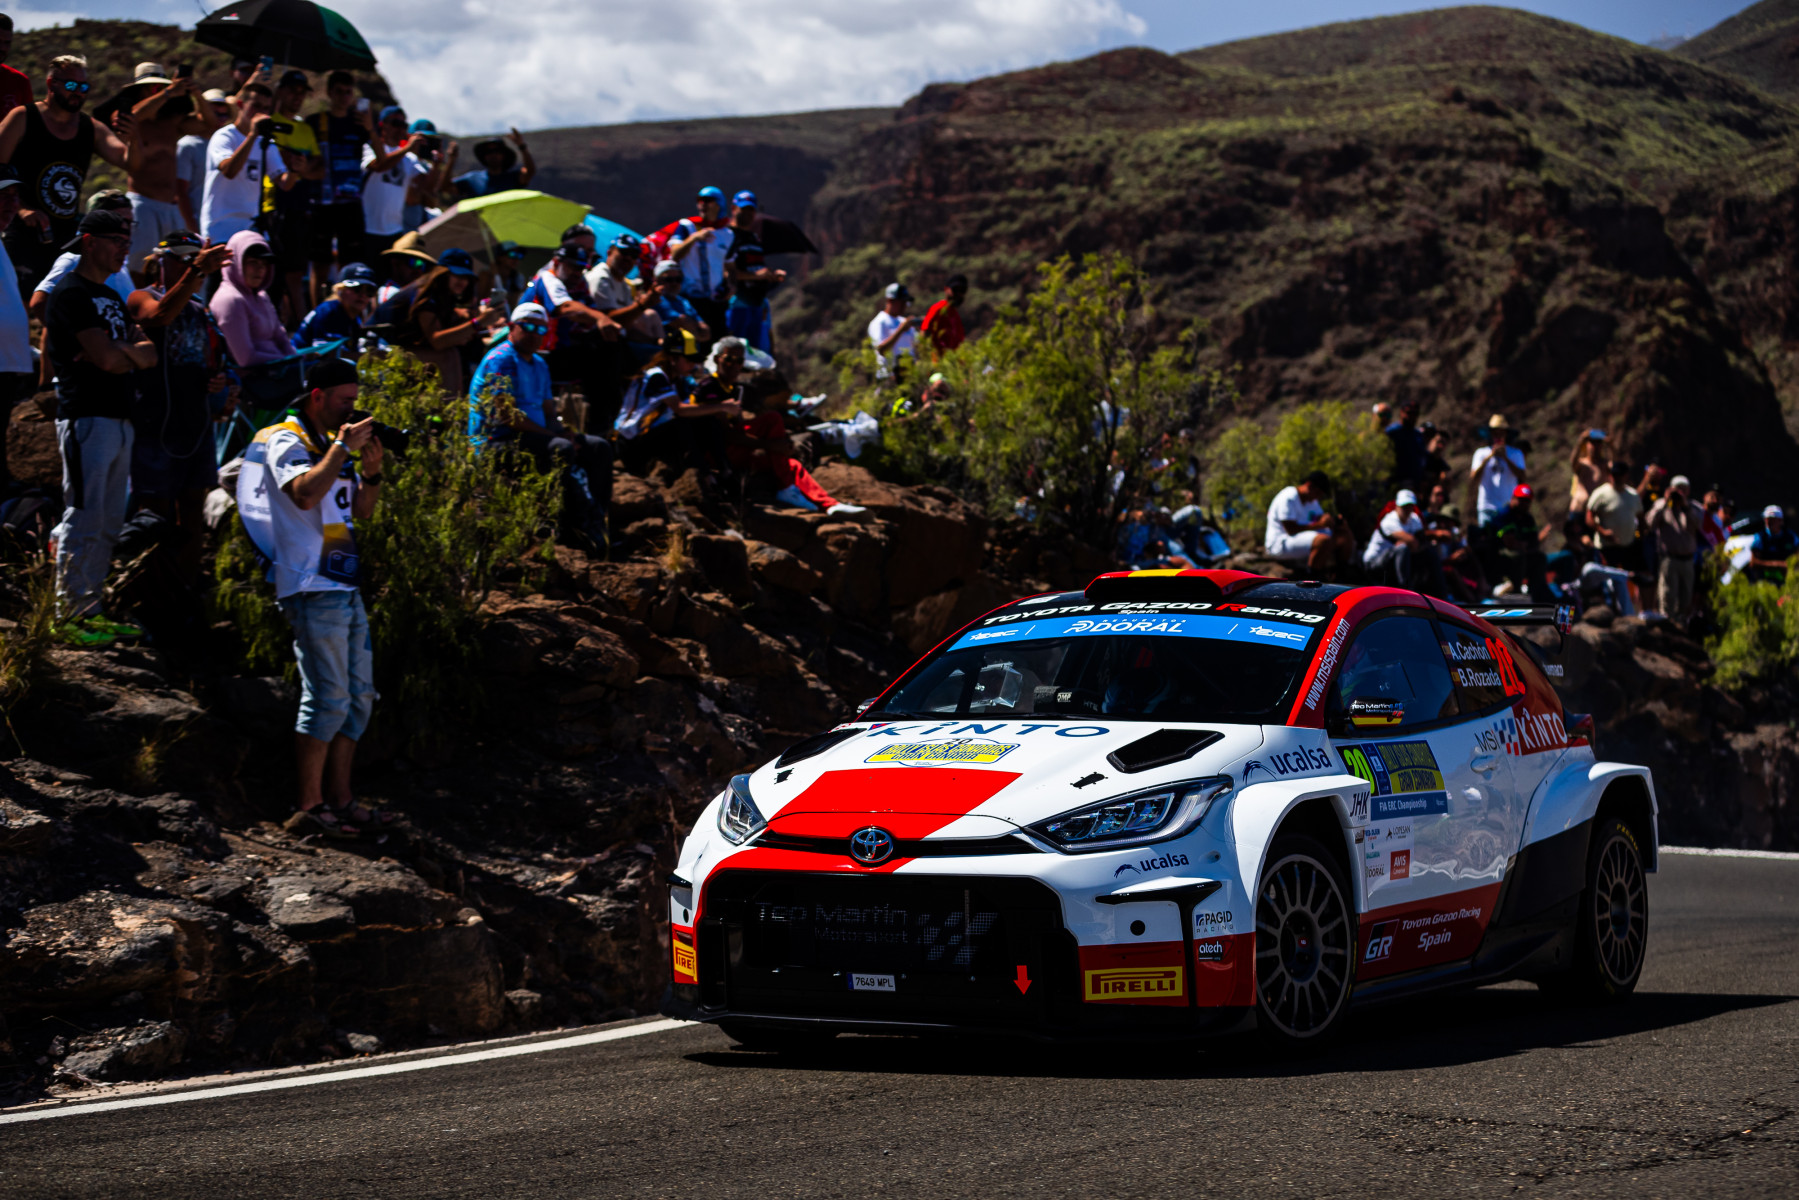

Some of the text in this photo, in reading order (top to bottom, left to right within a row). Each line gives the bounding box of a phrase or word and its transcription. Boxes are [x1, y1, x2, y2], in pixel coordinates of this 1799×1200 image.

[984, 601, 1326, 625] TOYOTA GAZOO Racing
[1448, 641, 1491, 662] A.Cachón
[1305, 618, 1351, 710] www.msispain.com
[1458, 667, 1502, 687] B.Rozada
[1269, 745, 1333, 775] ucalsa
[1350, 791, 1370, 817] JHK
[1140, 852, 1190, 872] ucalsa
[1205, 910, 1233, 925] PAGID
[1458, 907, 1482, 919] Racing
[1196, 923, 1234, 933] RACING
[1199, 940, 1222, 954] atech
[1365, 935, 1393, 960] GR
[1417, 928, 1452, 951] Spain
[855, 977, 894, 988] 7649 MPL
[1091, 970, 1176, 995] PIRELLI
